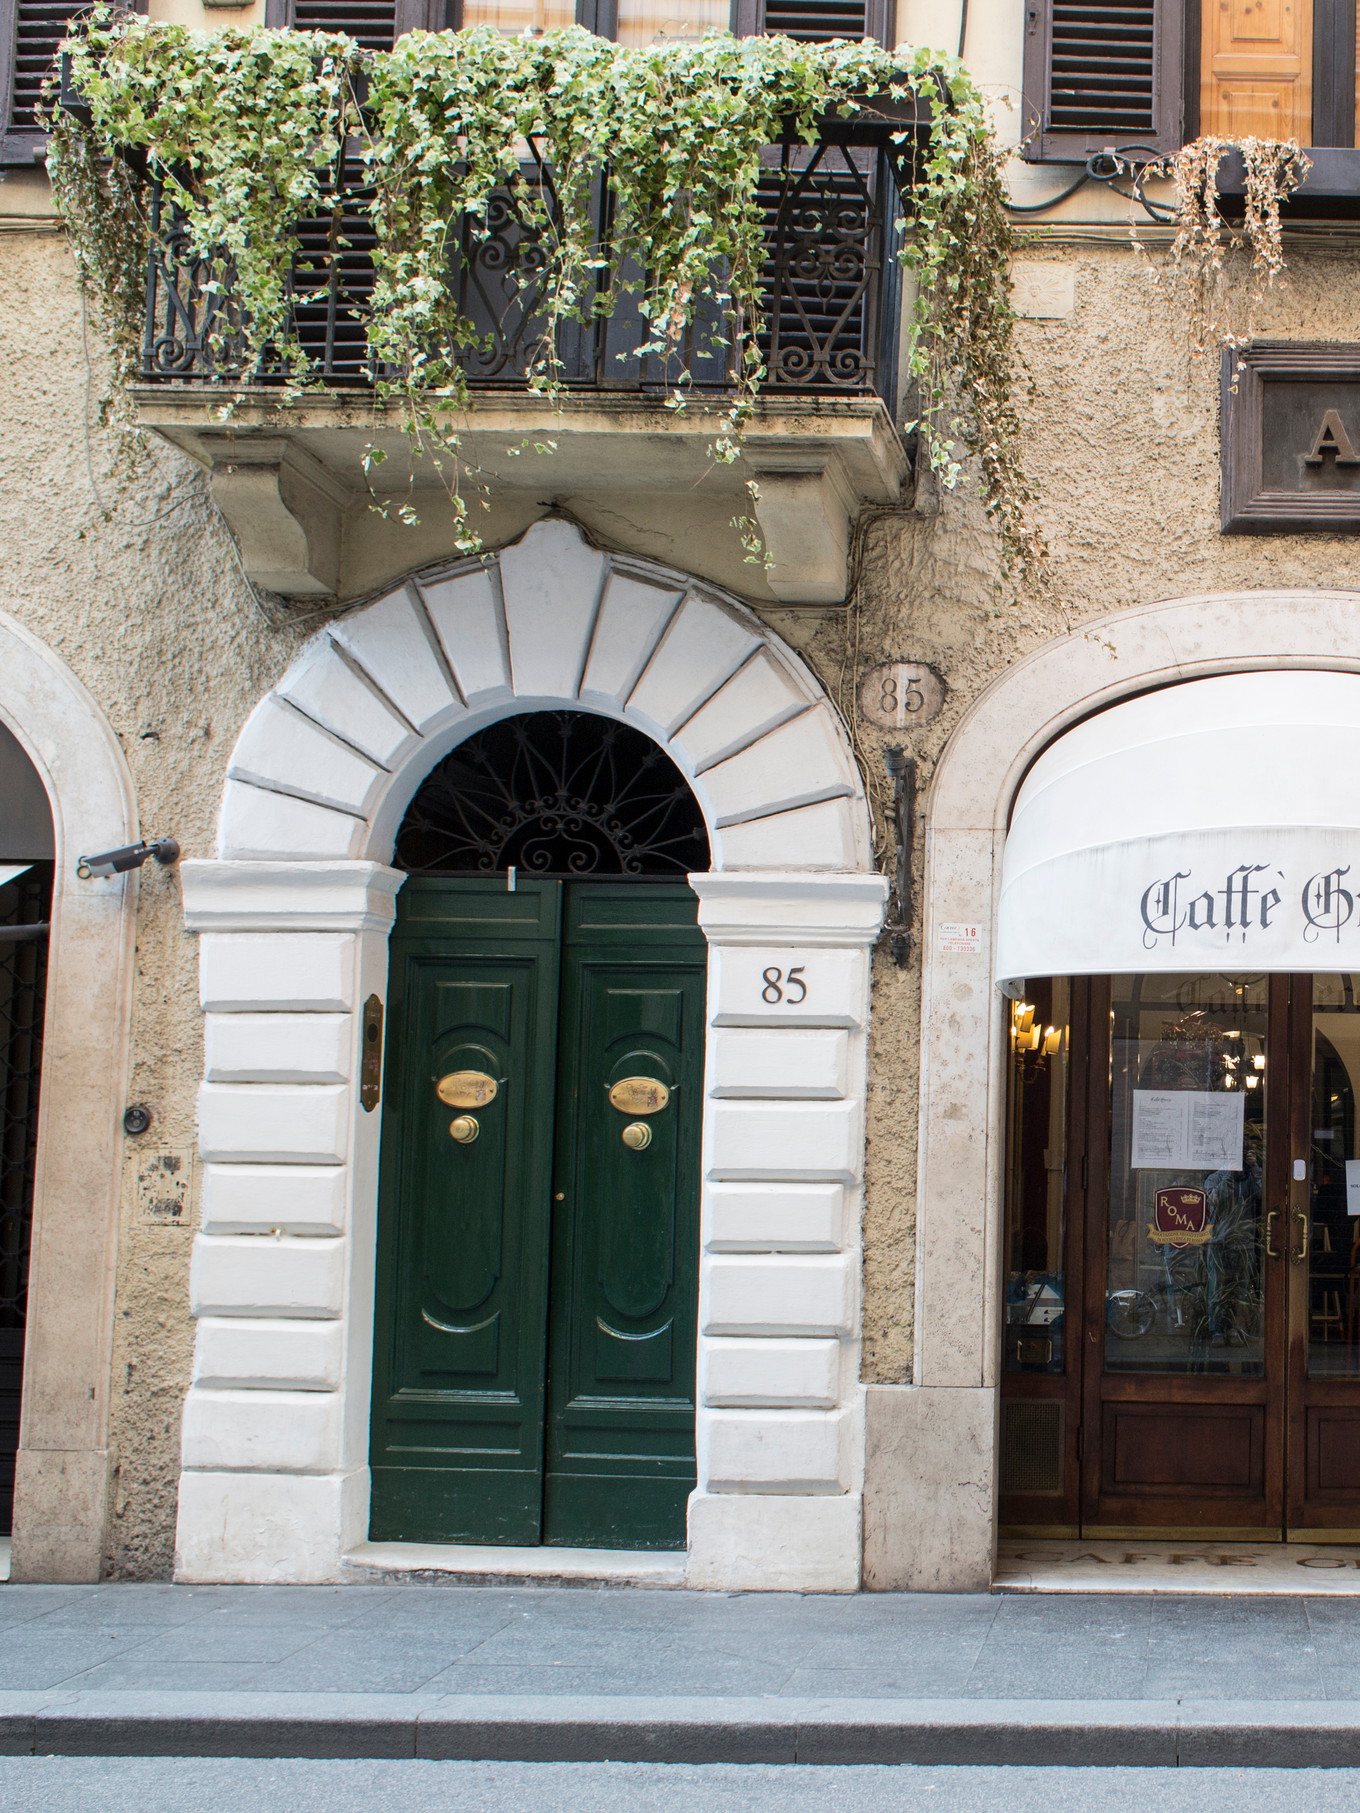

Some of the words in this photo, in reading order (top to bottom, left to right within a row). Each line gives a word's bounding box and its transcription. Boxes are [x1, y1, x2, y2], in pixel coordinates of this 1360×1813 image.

[881, 678, 924, 713] 85
[1140, 863, 1286, 950] Caffè
[761, 966, 808, 1004] 85
[1160, 1196, 1195, 1231] ROMA
